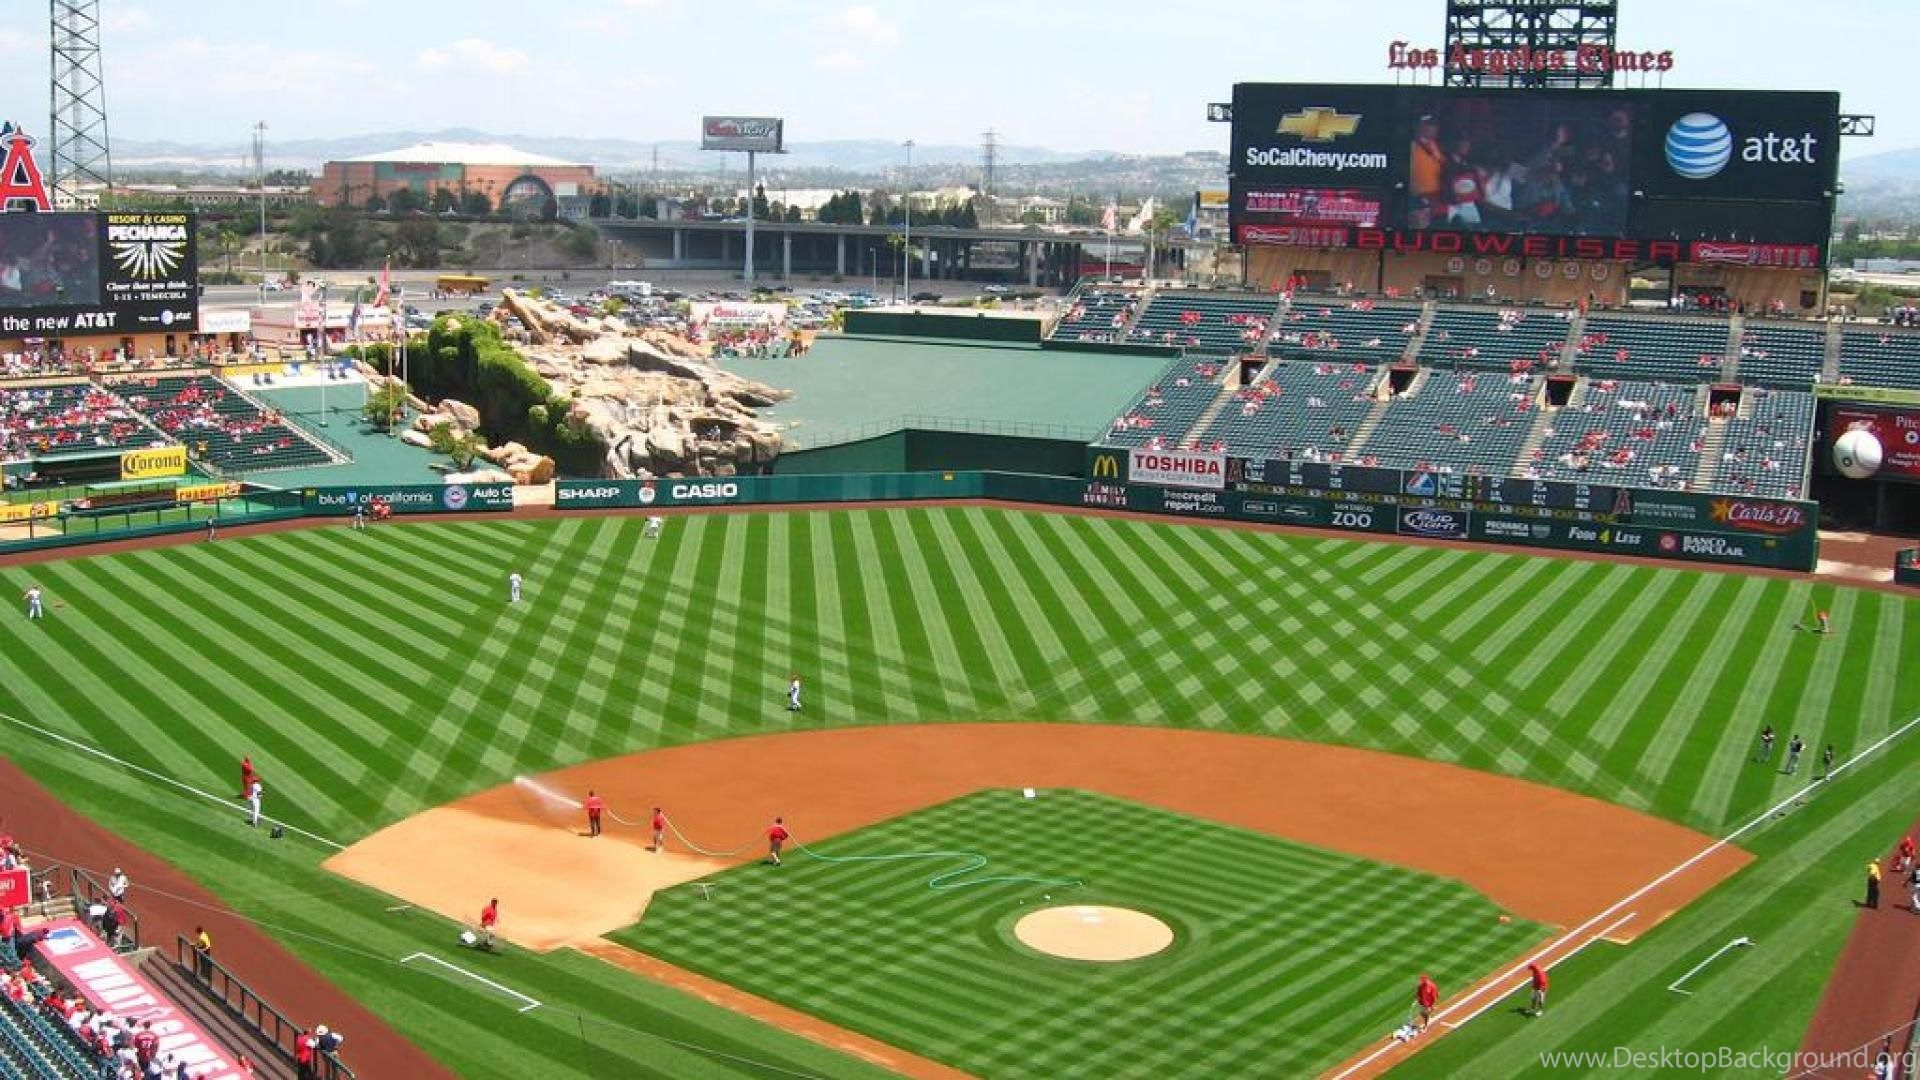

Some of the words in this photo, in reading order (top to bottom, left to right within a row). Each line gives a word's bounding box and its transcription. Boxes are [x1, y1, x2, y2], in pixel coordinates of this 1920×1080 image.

[1388, 41, 1439, 69] Los
[1450, 40, 1565, 74] Angeles
[1576, 42, 1674, 72] Times
[1742, 132, 1818, 164] at&t
[1246, 147, 1388, 171] SoCalChevy.com
[153, 215, 186, 224] CASINO
[108, 225, 188, 241] PECHANGA
[1357, 229, 1680, 261] BUDWEISER
[3, 314, 31, 331] the
[35, 315, 69, 330] new
[74, 312, 117, 328] AT&T
[123, 452, 183, 474] Corona
[1134, 454, 1221, 475] TOSHIBA
[472, 488, 500, 499] Auto
[558, 486, 622, 500] SHARP
[672, 483, 738, 499] CASIO
[318, 494, 347, 505] blue
[1331, 511, 1373, 528] ZOO
[1598, 529, 1610, 544] 4
[1683, 535, 1727, 548] BANCO
